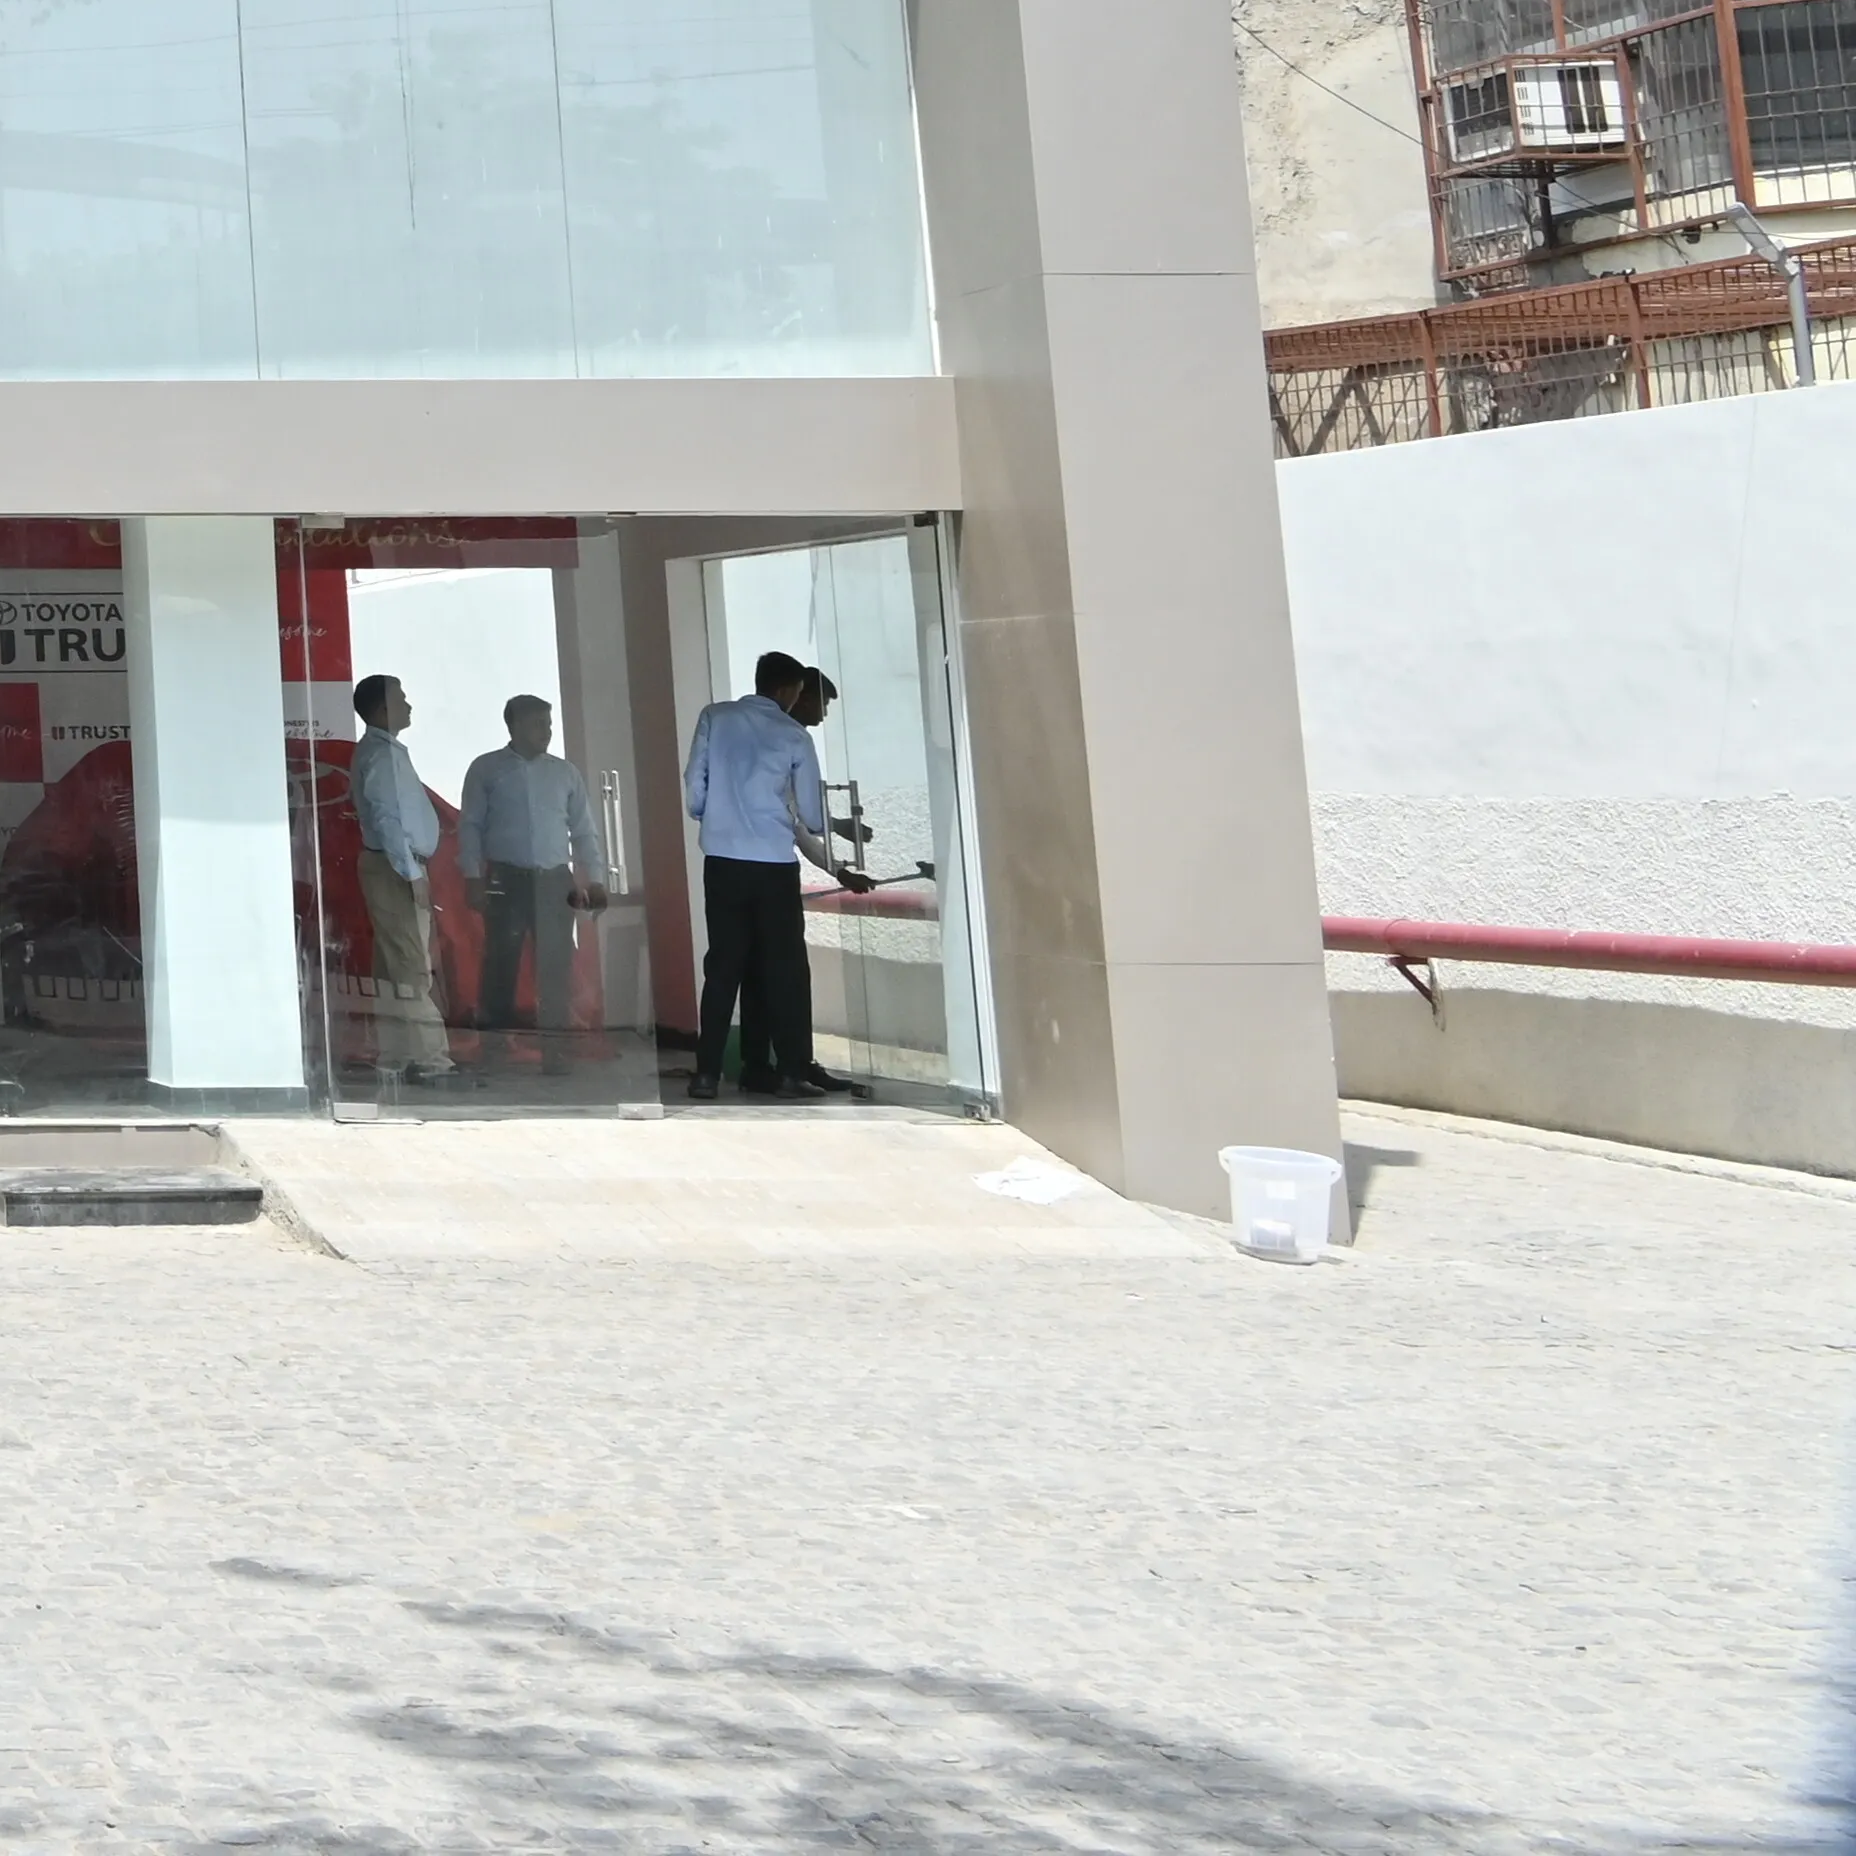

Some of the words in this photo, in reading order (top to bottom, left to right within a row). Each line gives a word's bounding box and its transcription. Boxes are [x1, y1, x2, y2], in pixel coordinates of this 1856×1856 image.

[20, 602, 124, 622] TOYOTA
[24, 628, 126, 662] TRU
[68, 725, 131, 740] TRUST
